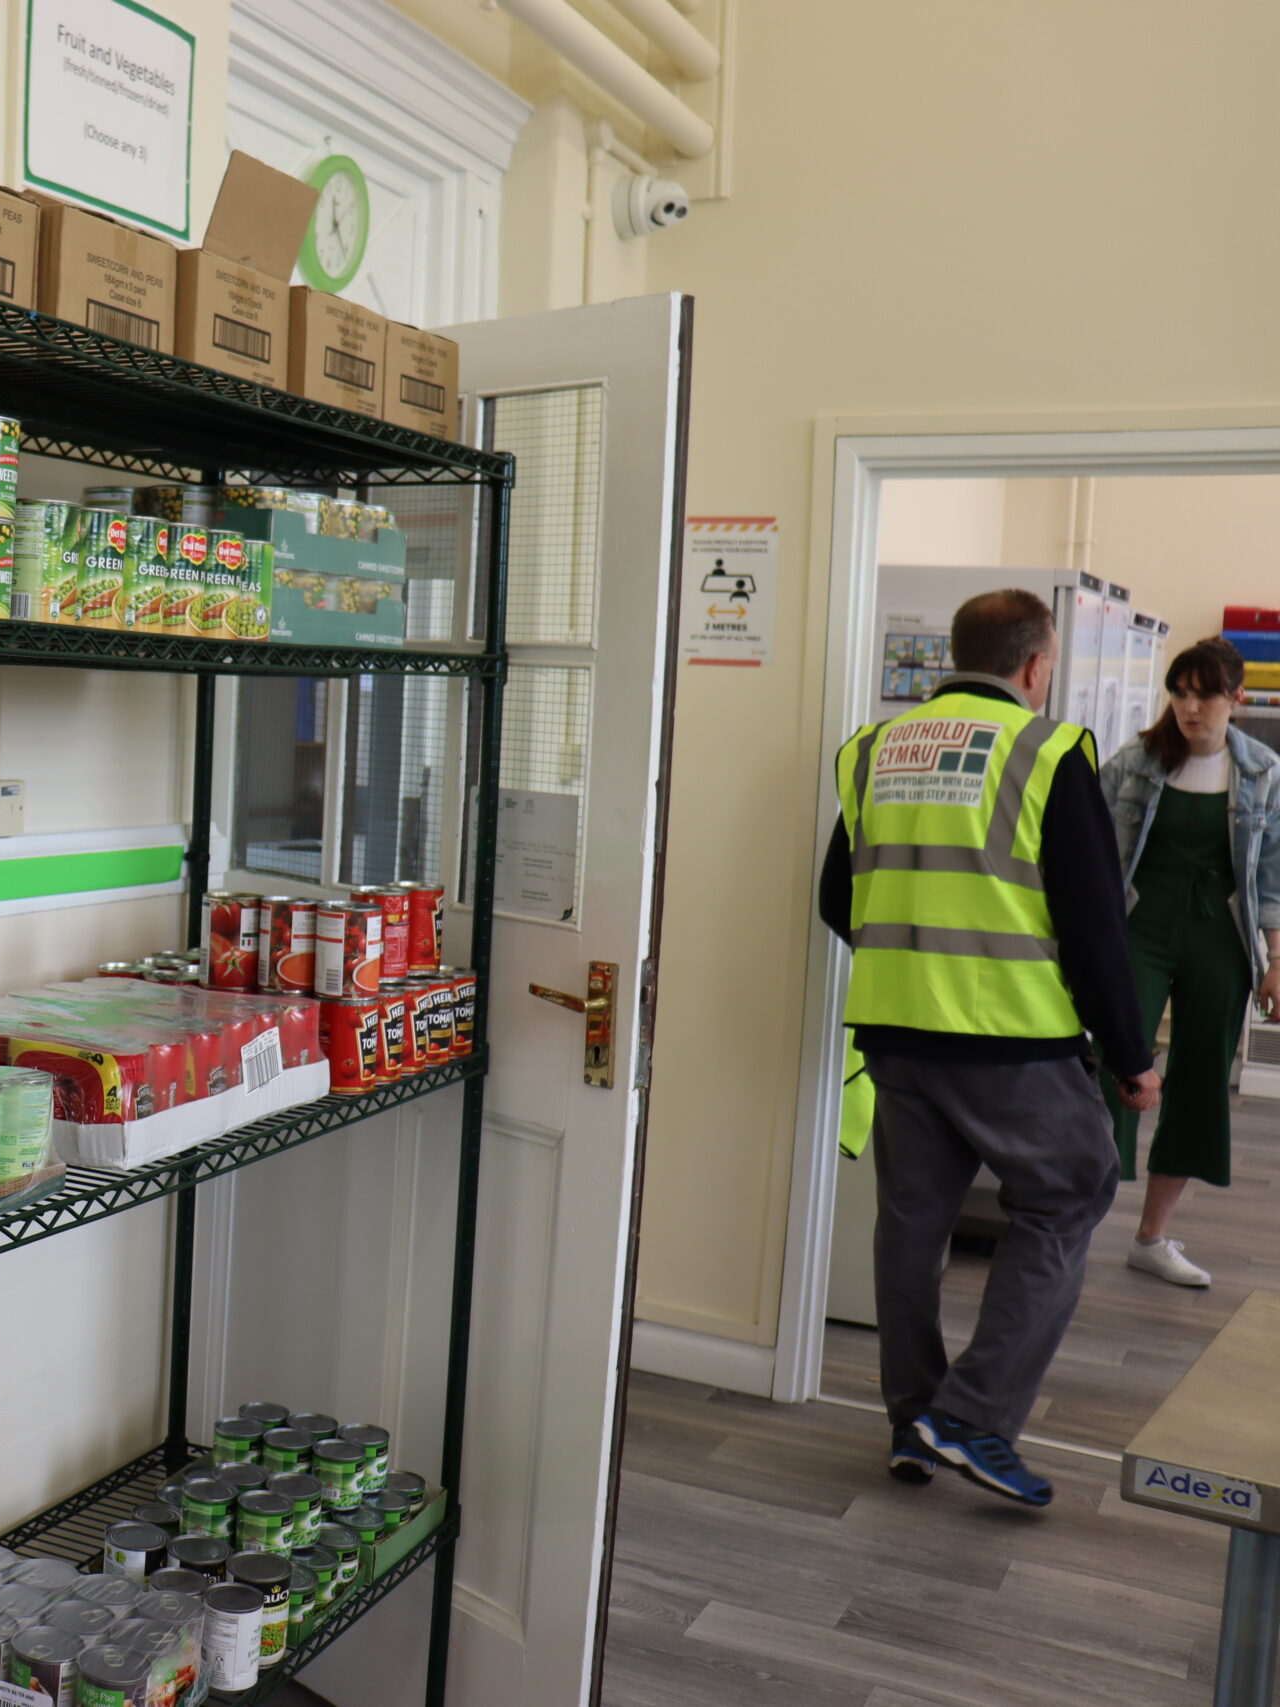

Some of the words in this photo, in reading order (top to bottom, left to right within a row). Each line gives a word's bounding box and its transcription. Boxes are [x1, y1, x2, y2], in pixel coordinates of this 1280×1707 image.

[57, 24, 86, 55] Fruit
[89, 43, 112, 65] and
[114, 51, 175, 96] Vegetables
[84, 123, 119, 148] (Choose
[121, 141, 137, 160] any
[138, 145, 148, 163] 3)
[3, 207, 23, 224] PEAS
[87, 253, 129, 276] SWEETCORN
[130, 268, 145, 282] AND
[145, 273, 164, 289] PEAS
[216, 269, 249, 291] SWEETCORN
[183, 541, 193, 552] Del
[219, 546, 229, 557] Del
[63, 551, 79, 564] GRE
[86, 556, 123, 571] GREEN
[138, 562, 167, 577] GREE
[205, 573, 235, 586] REEN
[242, 580, 262, 592] EAS
[704, 622, 710, 631] 2
[712, 623, 748, 632] METRES
[885, 721, 965, 744] FOOTHOLD
[877, 744, 933, 768] CYMRU
[924, 789, 945, 801] STEP
[948, 790, 958, 801] BY
[958, 791, 980, 803] STEP
[433, 991, 453, 1004] HEIN
[460, 986, 475, 998] HEIN
[392, 1005, 404, 1019] HEI
[429, 1012, 453, 1024] TOMAT
[455, 1006, 474, 1017] TOMA
[367, 1013, 378, 1028] HEI
[387, 1027, 403, 1039] TOM
[362, 1036, 377, 1050] TOM
[106, 1085, 118, 1098] 4
[1145, 1466, 1251, 1508] Adexa
[264, 1589, 290, 1603] aucy
